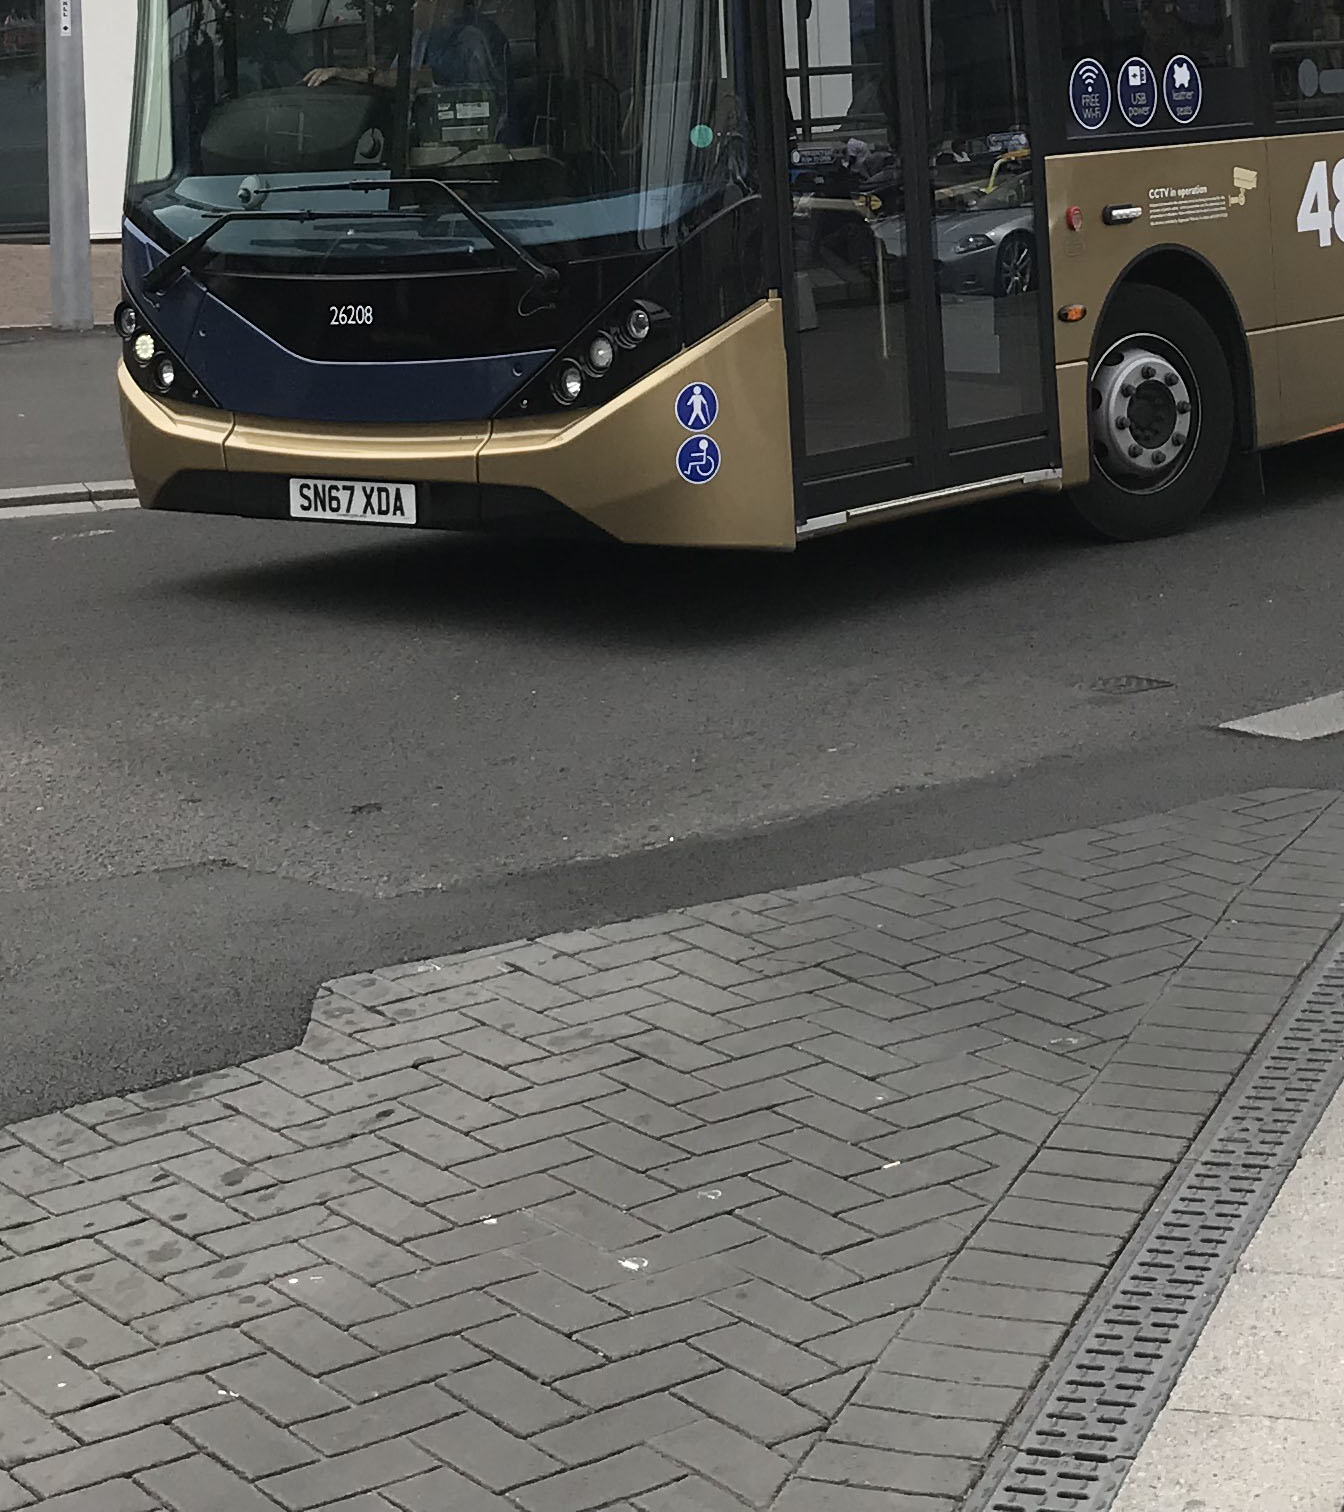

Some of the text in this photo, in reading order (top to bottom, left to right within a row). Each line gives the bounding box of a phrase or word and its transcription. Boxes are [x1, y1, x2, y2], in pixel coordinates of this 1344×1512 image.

[1082, 93, 1100, 107] FREE
[1131, 92, 1147, 105] USB
[1172, 89, 1194, 102] leather
[1128, 105, 1150, 118] power
[1176, 104, 1193, 116] seats
[1149, 185, 1207, 199] CCTV in operation
[329, 305, 373, 326] 26208
[299, 482, 405, 516] SN67 XDA
